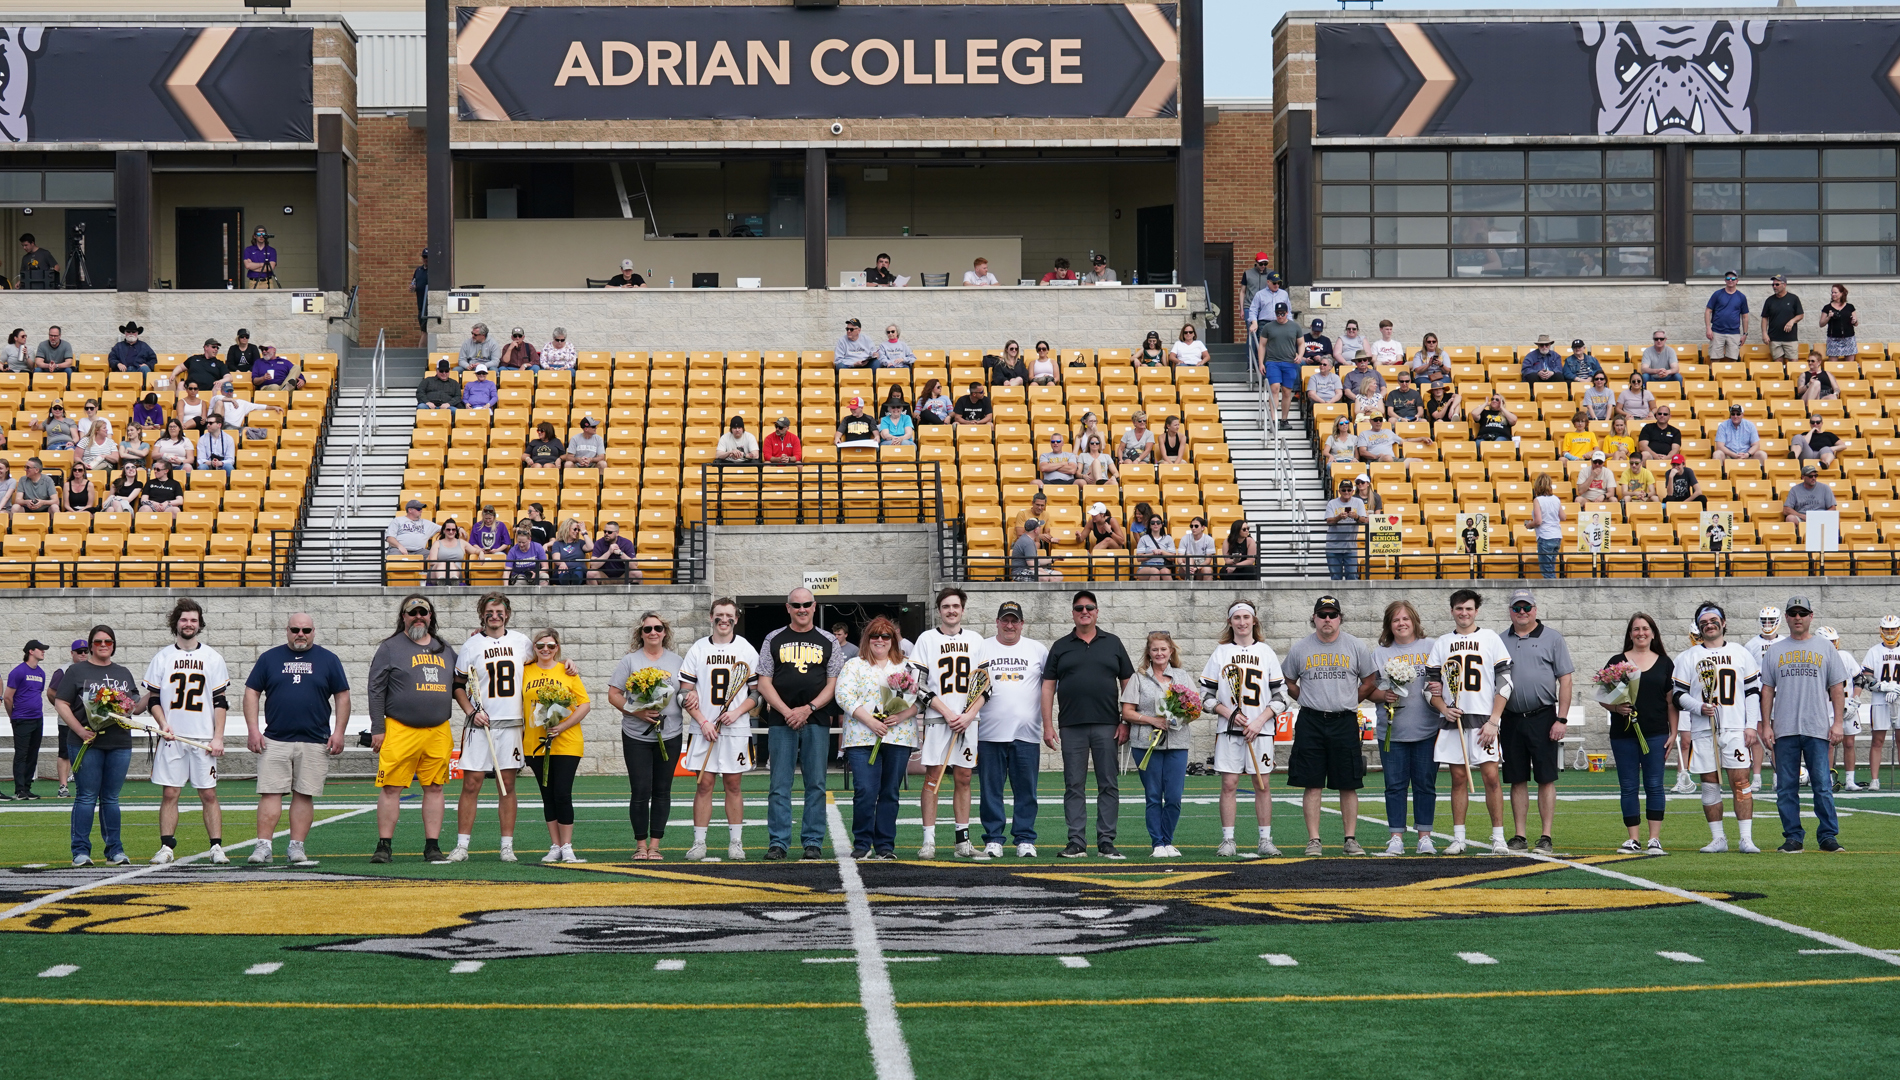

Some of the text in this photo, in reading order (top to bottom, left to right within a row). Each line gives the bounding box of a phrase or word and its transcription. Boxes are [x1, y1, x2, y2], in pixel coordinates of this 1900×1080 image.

[554, 38, 1083, 87] ADRIAN COLLEGE
[302, 298, 314, 312] E
[458, 298, 470, 312] D
[1164, 294, 1177, 308] D
[1320, 292, 1332, 306] C
[484, 646, 514, 659] ADRIAN
[800, 641, 823, 650] COLLEGE
[940, 642, 969, 654] ADRIAN
[1450, 641, 1479, 652] ADRIAN
[412, 654, 445, 669] ADRIAN
[706, 654, 736, 665] ADRIAN
[779, 646, 823, 664] BULLDOGS
[1231, 654, 1260, 666] ADRIAN
[1305, 652, 1350, 670] ADRIAN
[1778, 650, 1823, 668] ADRIAN
[174, 659, 204, 671] ADRIAN
[990, 658, 1028, 667] ADRIAN
[485, 660, 516, 698] 18
[938, 655, 971, 696] 28
[1308, 672, 1346, 680] LACROSSE
[1781, 668, 1818, 678] LACROSSE
[169, 672, 206, 712] 32
[416, 683, 447, 692] LACROSSE
[710, 668, 730, 706] 8
[1278, 715, 1287, 724] G
[512, 747, 522, 762] AC
[736, 752, 746, 766] AC
[962, 747, 973, 762] AC
[1261, 753, 1270, 766] AC
[1734, 748, 1745, 762] AC
